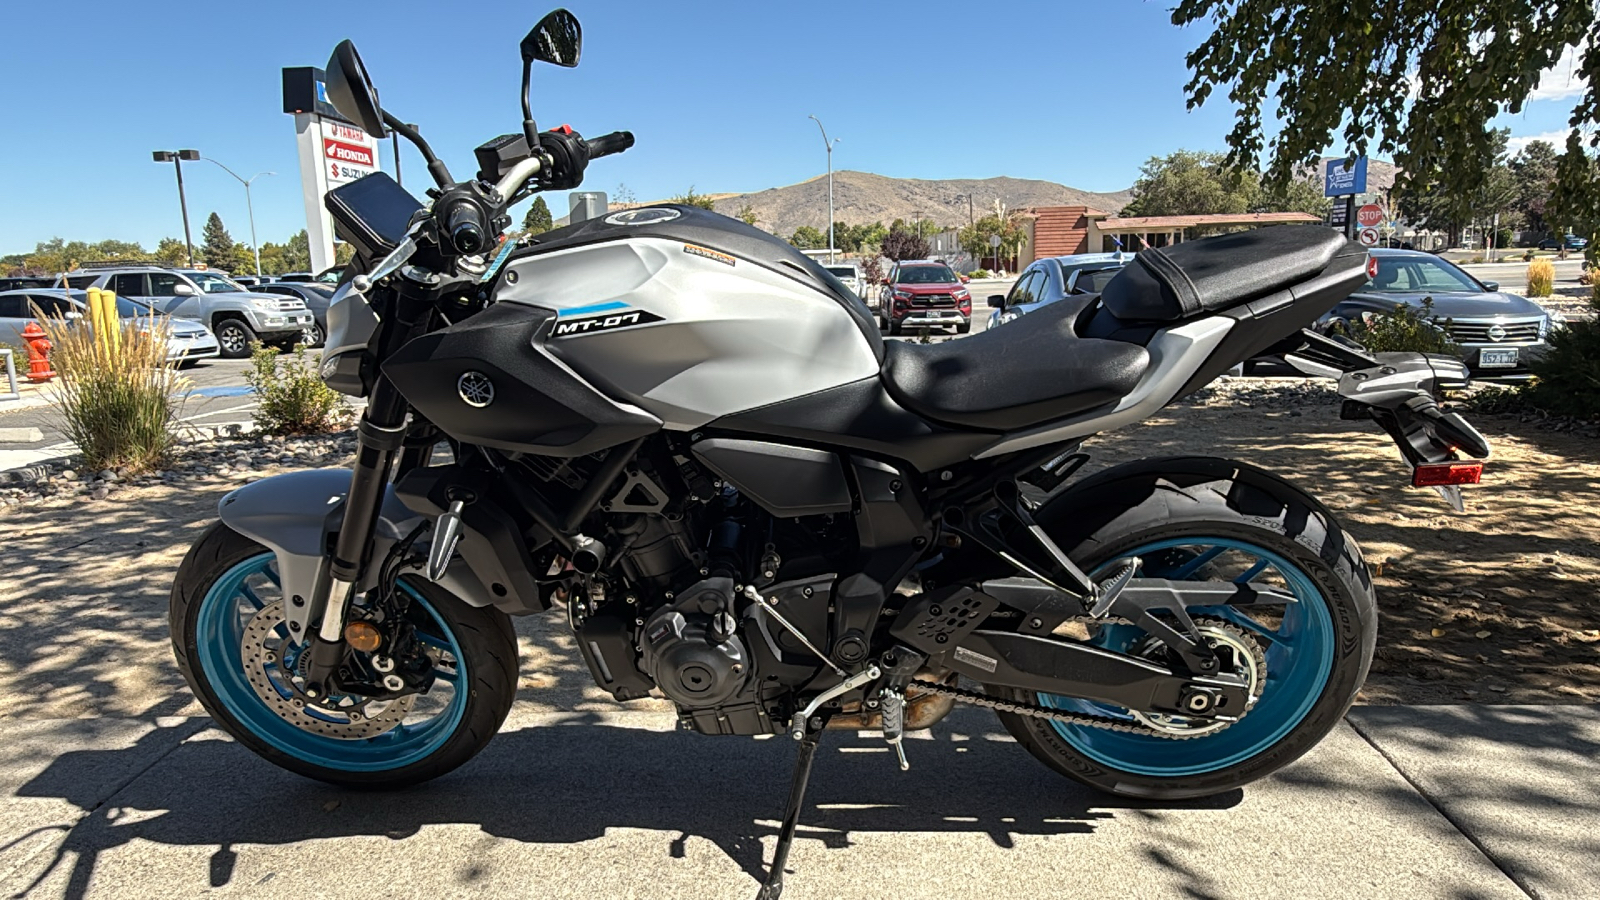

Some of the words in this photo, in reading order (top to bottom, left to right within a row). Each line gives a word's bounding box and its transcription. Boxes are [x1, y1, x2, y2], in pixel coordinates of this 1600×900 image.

[339, 127, 364, 142] YAMAHA
[337, 147, 372, 163] HONDA
[1360, 211, 1381, 220] STOP
[557, 313, 640, 334] MT-07
[1328, 585, 1351, 633] DUNLOP
[1034, 719, 1083, 765] SPORTMA
